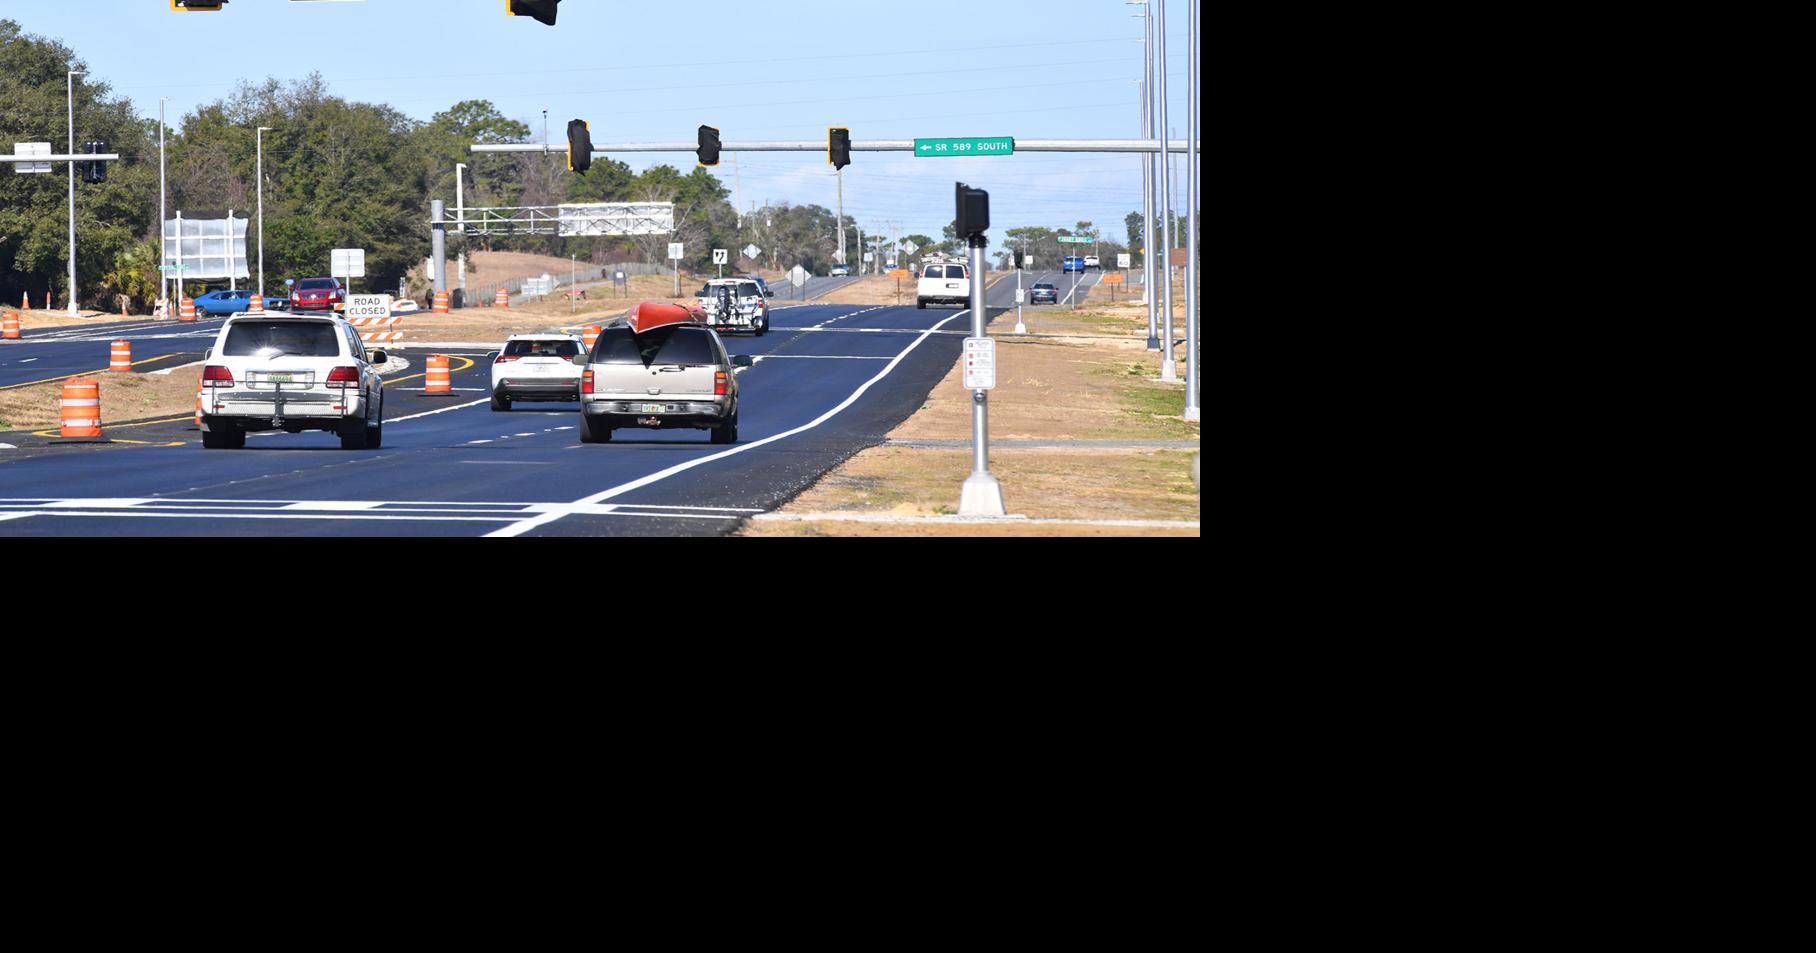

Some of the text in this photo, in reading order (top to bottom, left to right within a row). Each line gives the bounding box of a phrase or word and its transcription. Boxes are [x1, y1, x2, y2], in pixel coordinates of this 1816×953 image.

[935, 142, 1008, 151] SR 589 SOUTH
[350, 307, 386, 315] CLOSED
